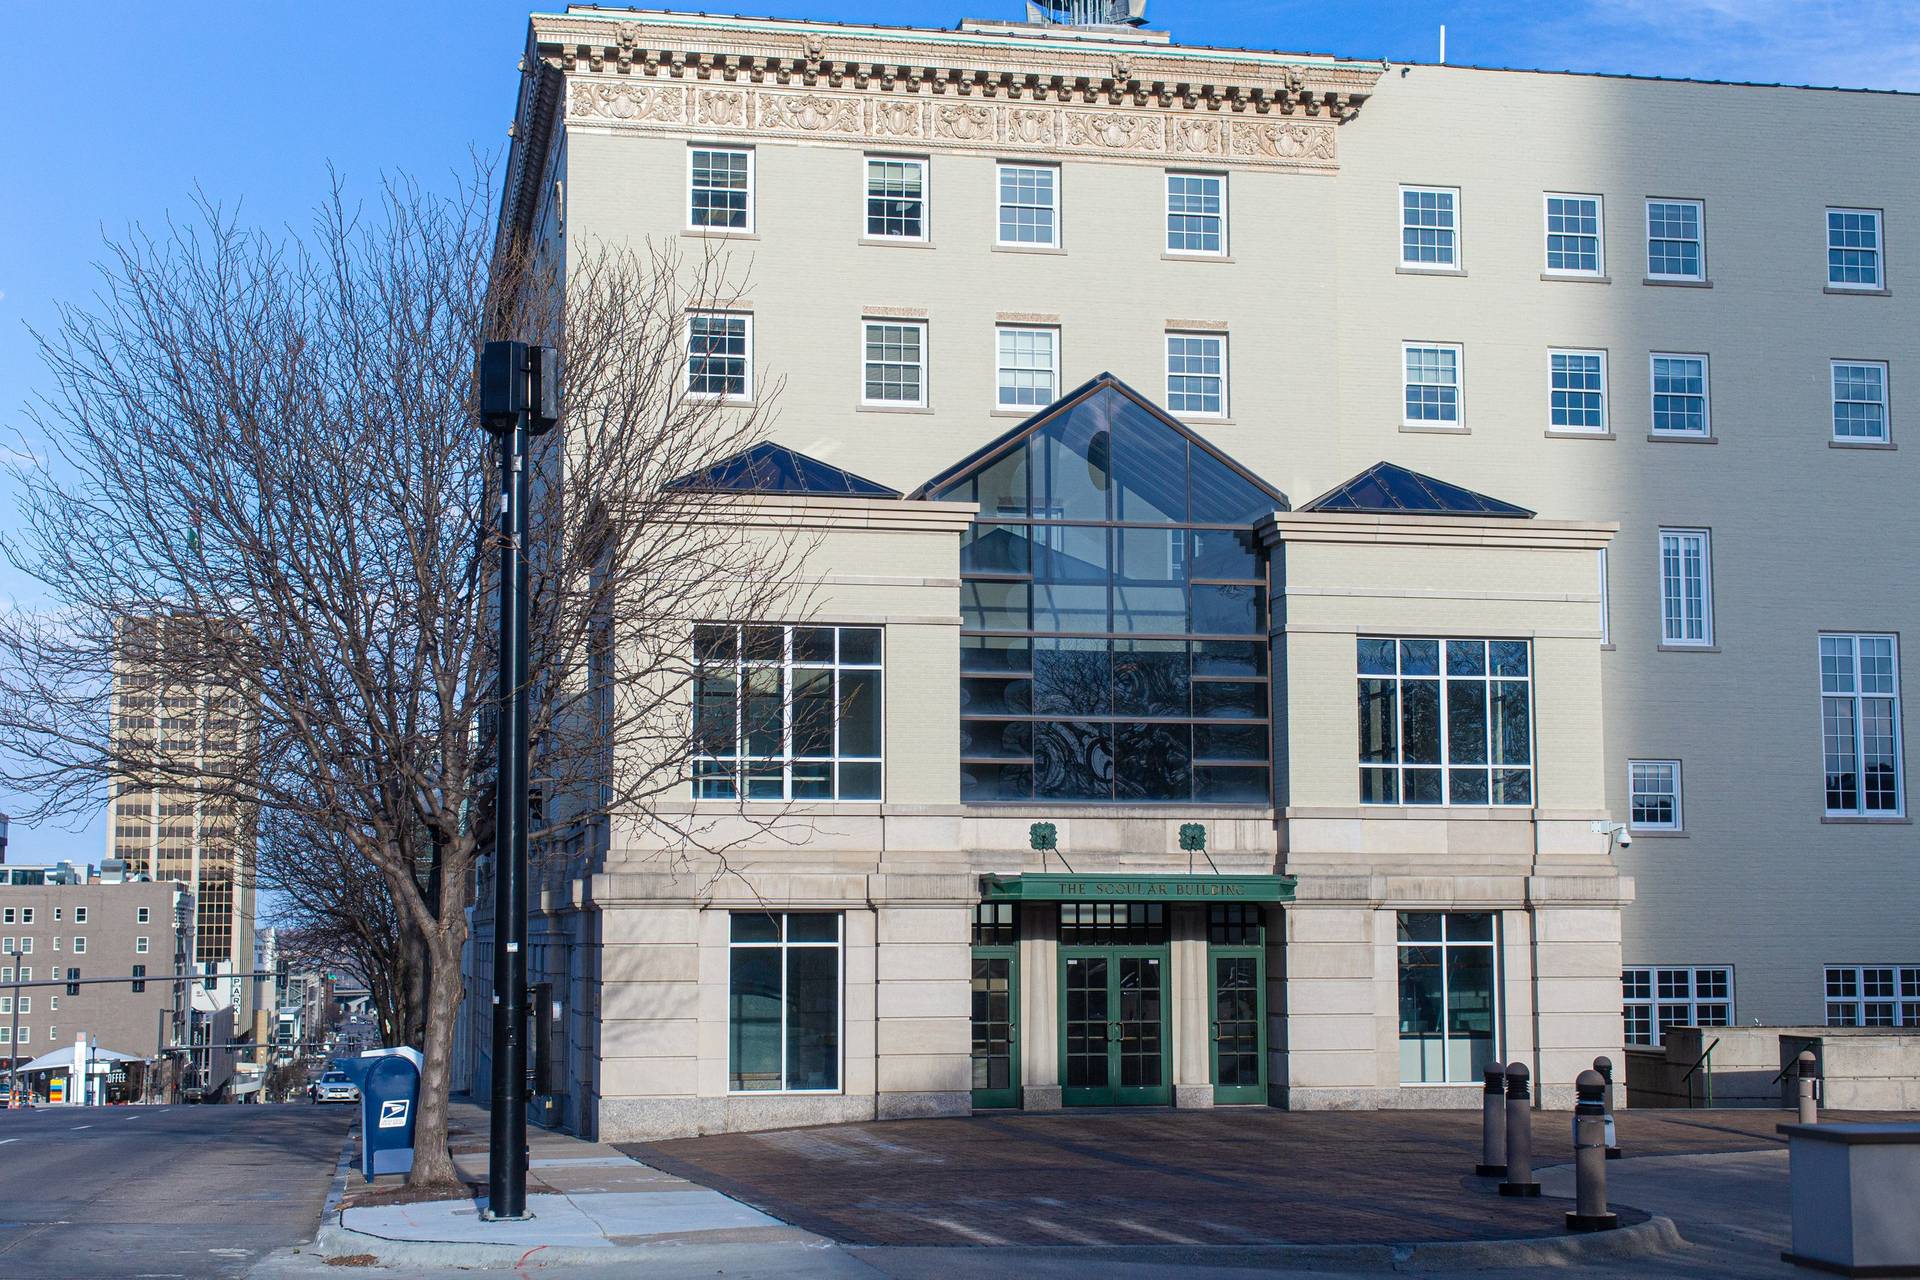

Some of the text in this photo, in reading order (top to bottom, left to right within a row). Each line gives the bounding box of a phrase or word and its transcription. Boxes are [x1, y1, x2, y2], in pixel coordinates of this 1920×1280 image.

[1058, 883, 1245, 896] THE SCOULAR BUILDING
[233, 978, 241, 1014] PARK
